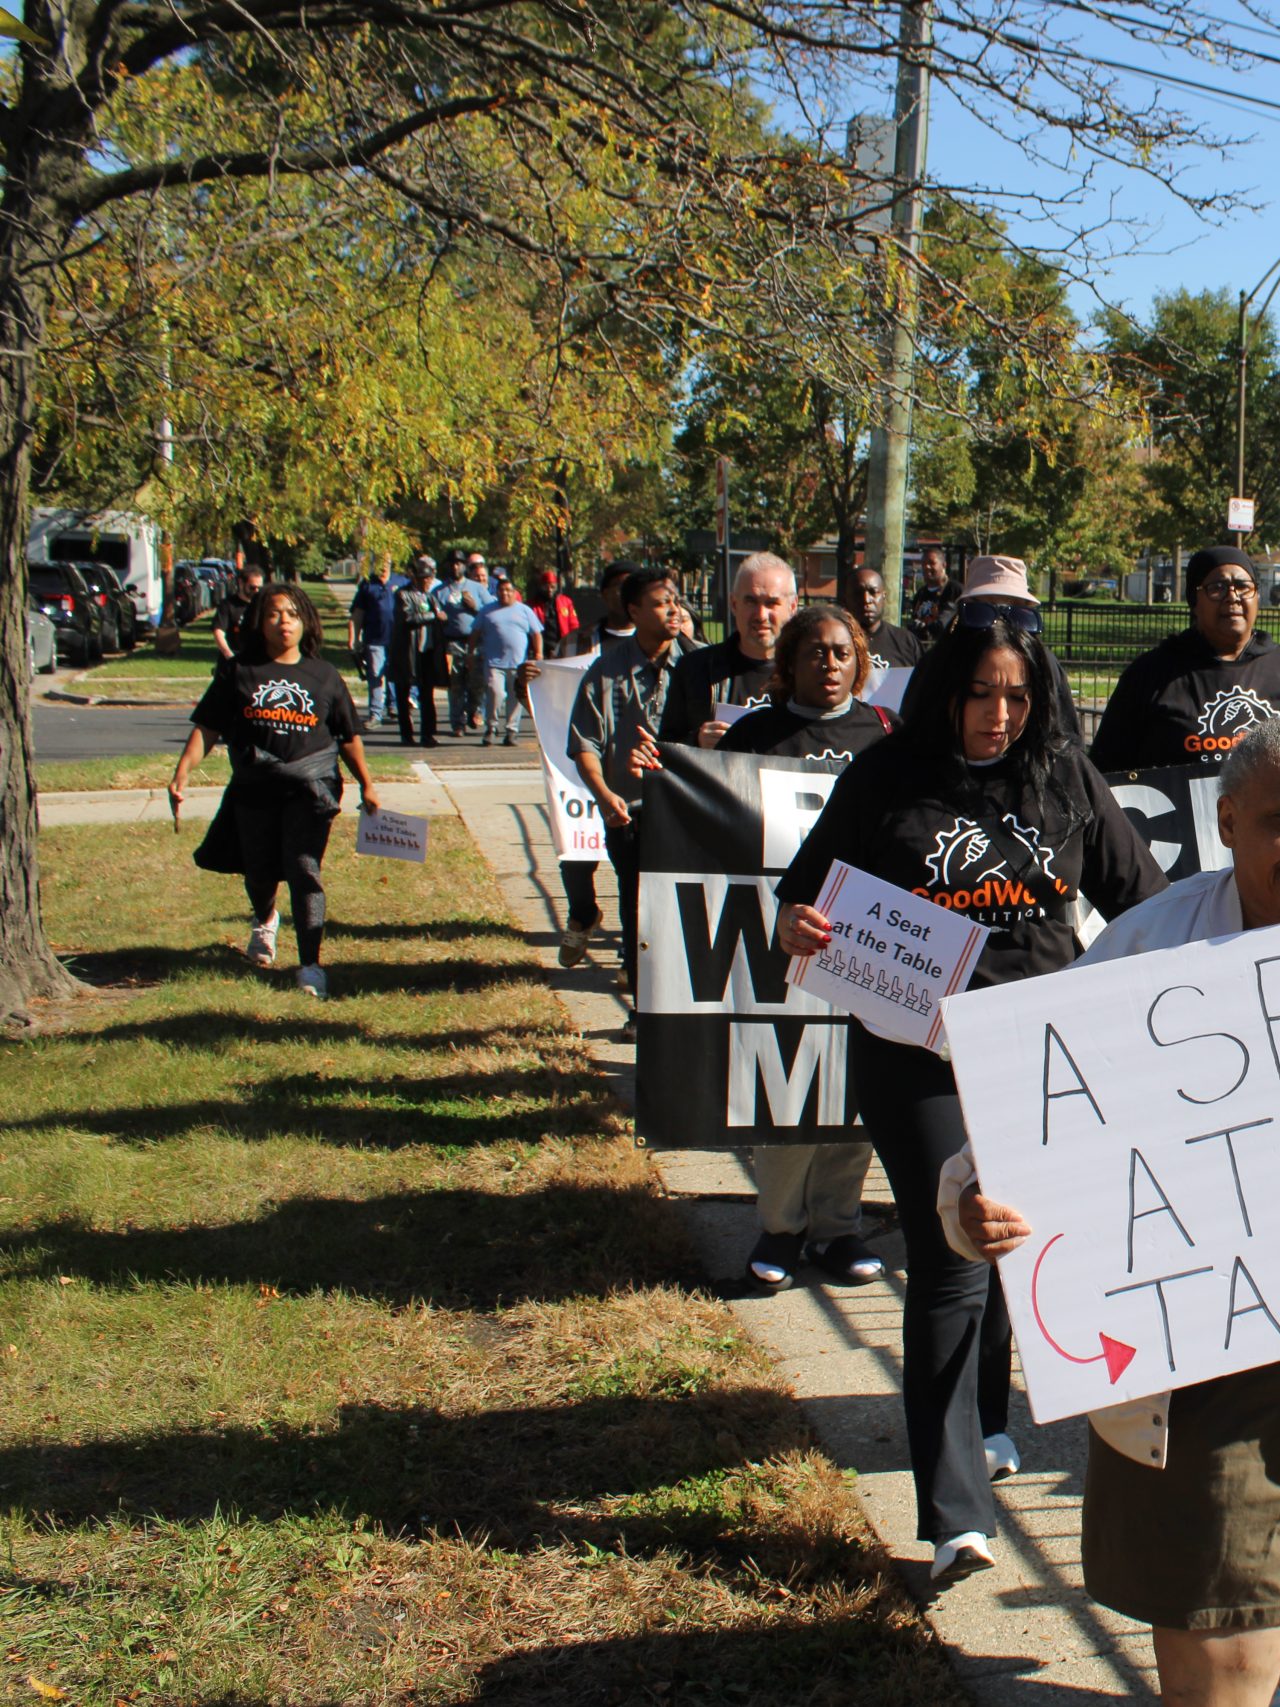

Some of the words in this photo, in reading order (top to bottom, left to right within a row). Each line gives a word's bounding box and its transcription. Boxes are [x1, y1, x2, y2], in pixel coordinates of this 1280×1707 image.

[242, 704, 319, 727] GoodWork
[253, 719, 310, 733] COALITION
[866, 902, 881, 920] A
[886, 909, 932, 942] Seat
[832, 920, 854, 938] at
[857, 927, 888, 955] the
[893, 943, 943, 979] Table
[1043, 1023, 1106, 1146] A
[1127, 1117, 1274, 1274] AT
